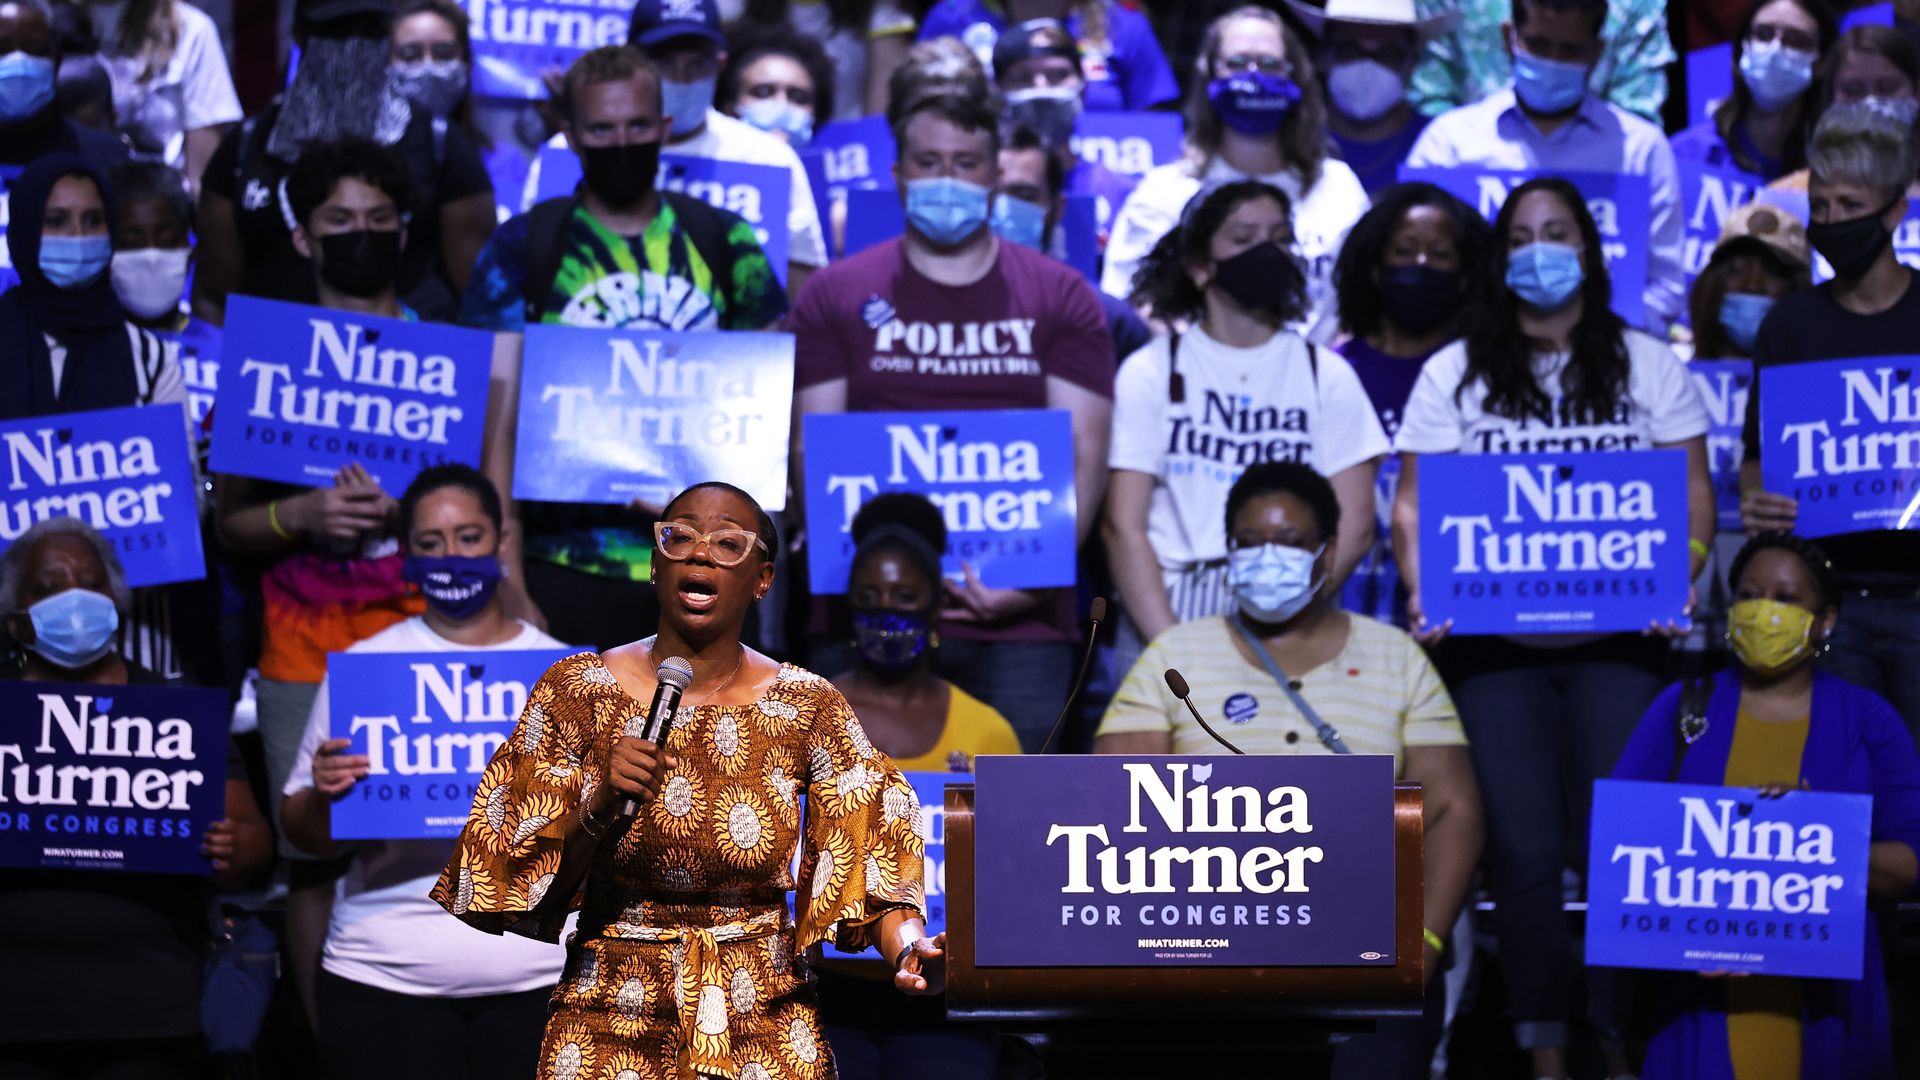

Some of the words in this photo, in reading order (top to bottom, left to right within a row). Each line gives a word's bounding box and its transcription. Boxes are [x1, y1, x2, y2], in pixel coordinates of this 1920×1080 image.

[468, 0, 630, 48] urne
[1069, 136, 1154, 176] na
[560, 270, 719, 332] ERNI
[303, 318, 458, 397] Nina
[869, 355, 914, 373] OVER
[875, 318, 1036, 356] POLICY
[605, 339, 759, 399] Nina
[1690, 370, 1749, 427] Ni
[1839, 367, 1920, 427] Ni
[240, 358, 463, 444] Turner
[541, 383, 764, 447] Turner
[1203, 389, 1310, 435] Nina
[2, 428, 160, 490] Nina
[245, 424, 293, 446] FOR
[886, 424, 1043, 484] Nina
[1167, 415, 1313, 466] Turner
[1780, 420, 1920, 480] Turn
[0, 482, 172, 541] urner
[826, 474, 1053, 533] Tner
[1502, 463, 1657, 523] Nina
[1439, 514, 1667, 573] Turner
[1453, 580, 1502, 598] FOR
[1516, 578, 1656, 597] CONGRESS
[410, 662, 534, 724] Nin
[35, 693, 196, 760] Nina
[350, 715, 508, 776] Turn
[0, 812, 30, 831] OR
[364, 784, 411, 802] FOR
[1123, 763, 1313, 833] Nina
[43, 847, 124, 859] NINATURNER.COM
[45, 814, 191, 838] CONGRESS
[1676, 797, 1836, 865] Nina
[1046, 824, 1324, 894] Turner
[1612, 844, 1843, 914] Turner
[1062, 905, 1121, 925] FOR
[1138, 938, 1229, 948] NINATURNER.COM
[1139, 905, 1311, 925] CONGRESS
[1622, 913, 1670, 932] FOR
[1687, 917, 1830, 941] CONGRESS
